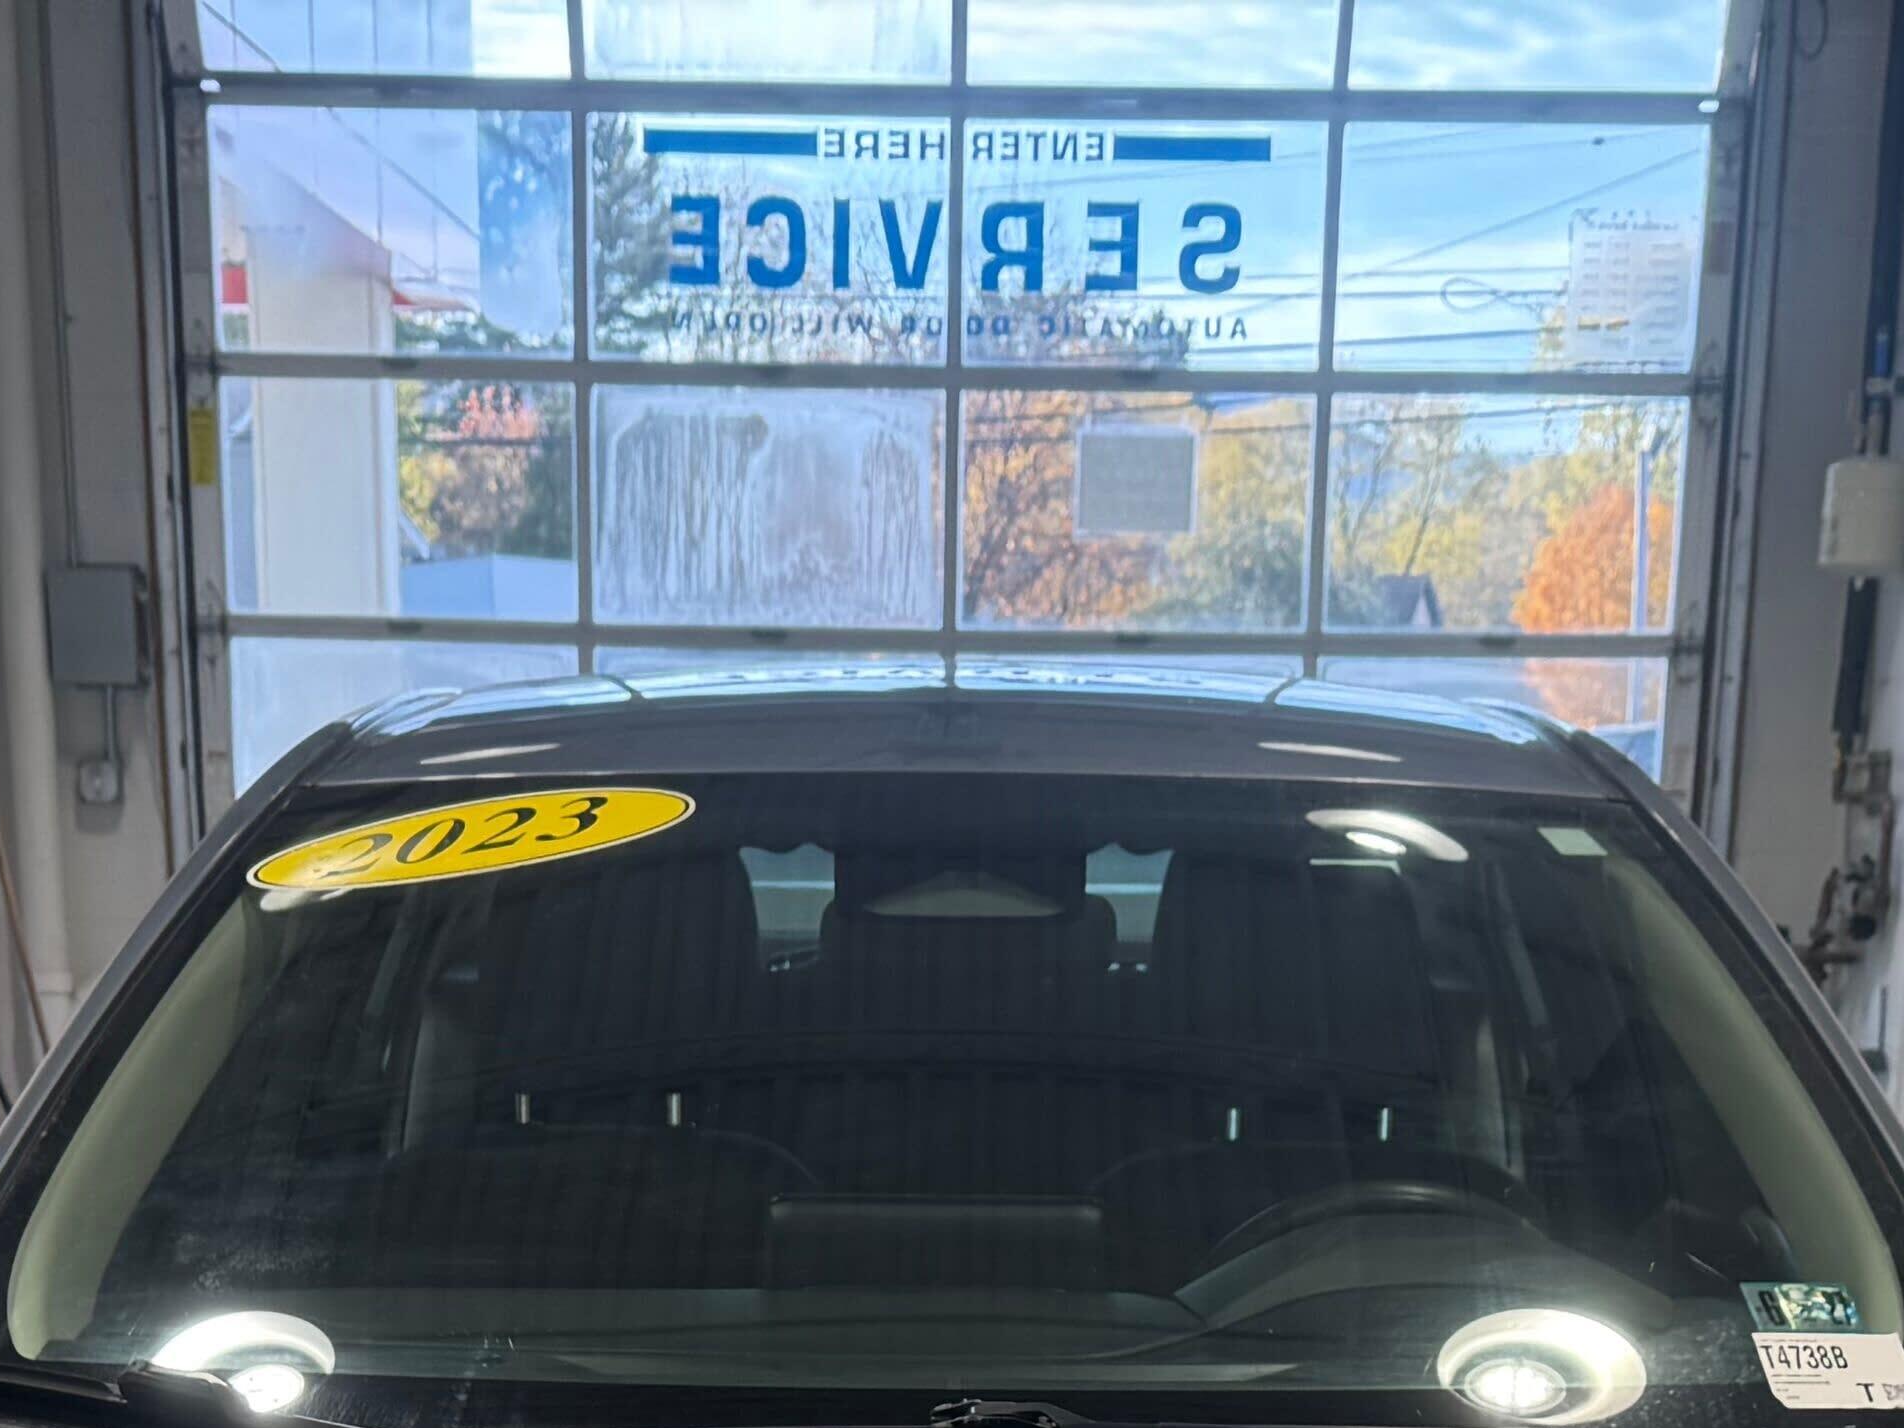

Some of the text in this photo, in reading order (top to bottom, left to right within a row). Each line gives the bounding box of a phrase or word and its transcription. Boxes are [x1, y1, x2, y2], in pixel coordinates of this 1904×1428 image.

[316, 796, 610, 880] 2023
[1759, 1345, 1849, 1370] T4738B
[1856, 1382, 1875, 1403] T
